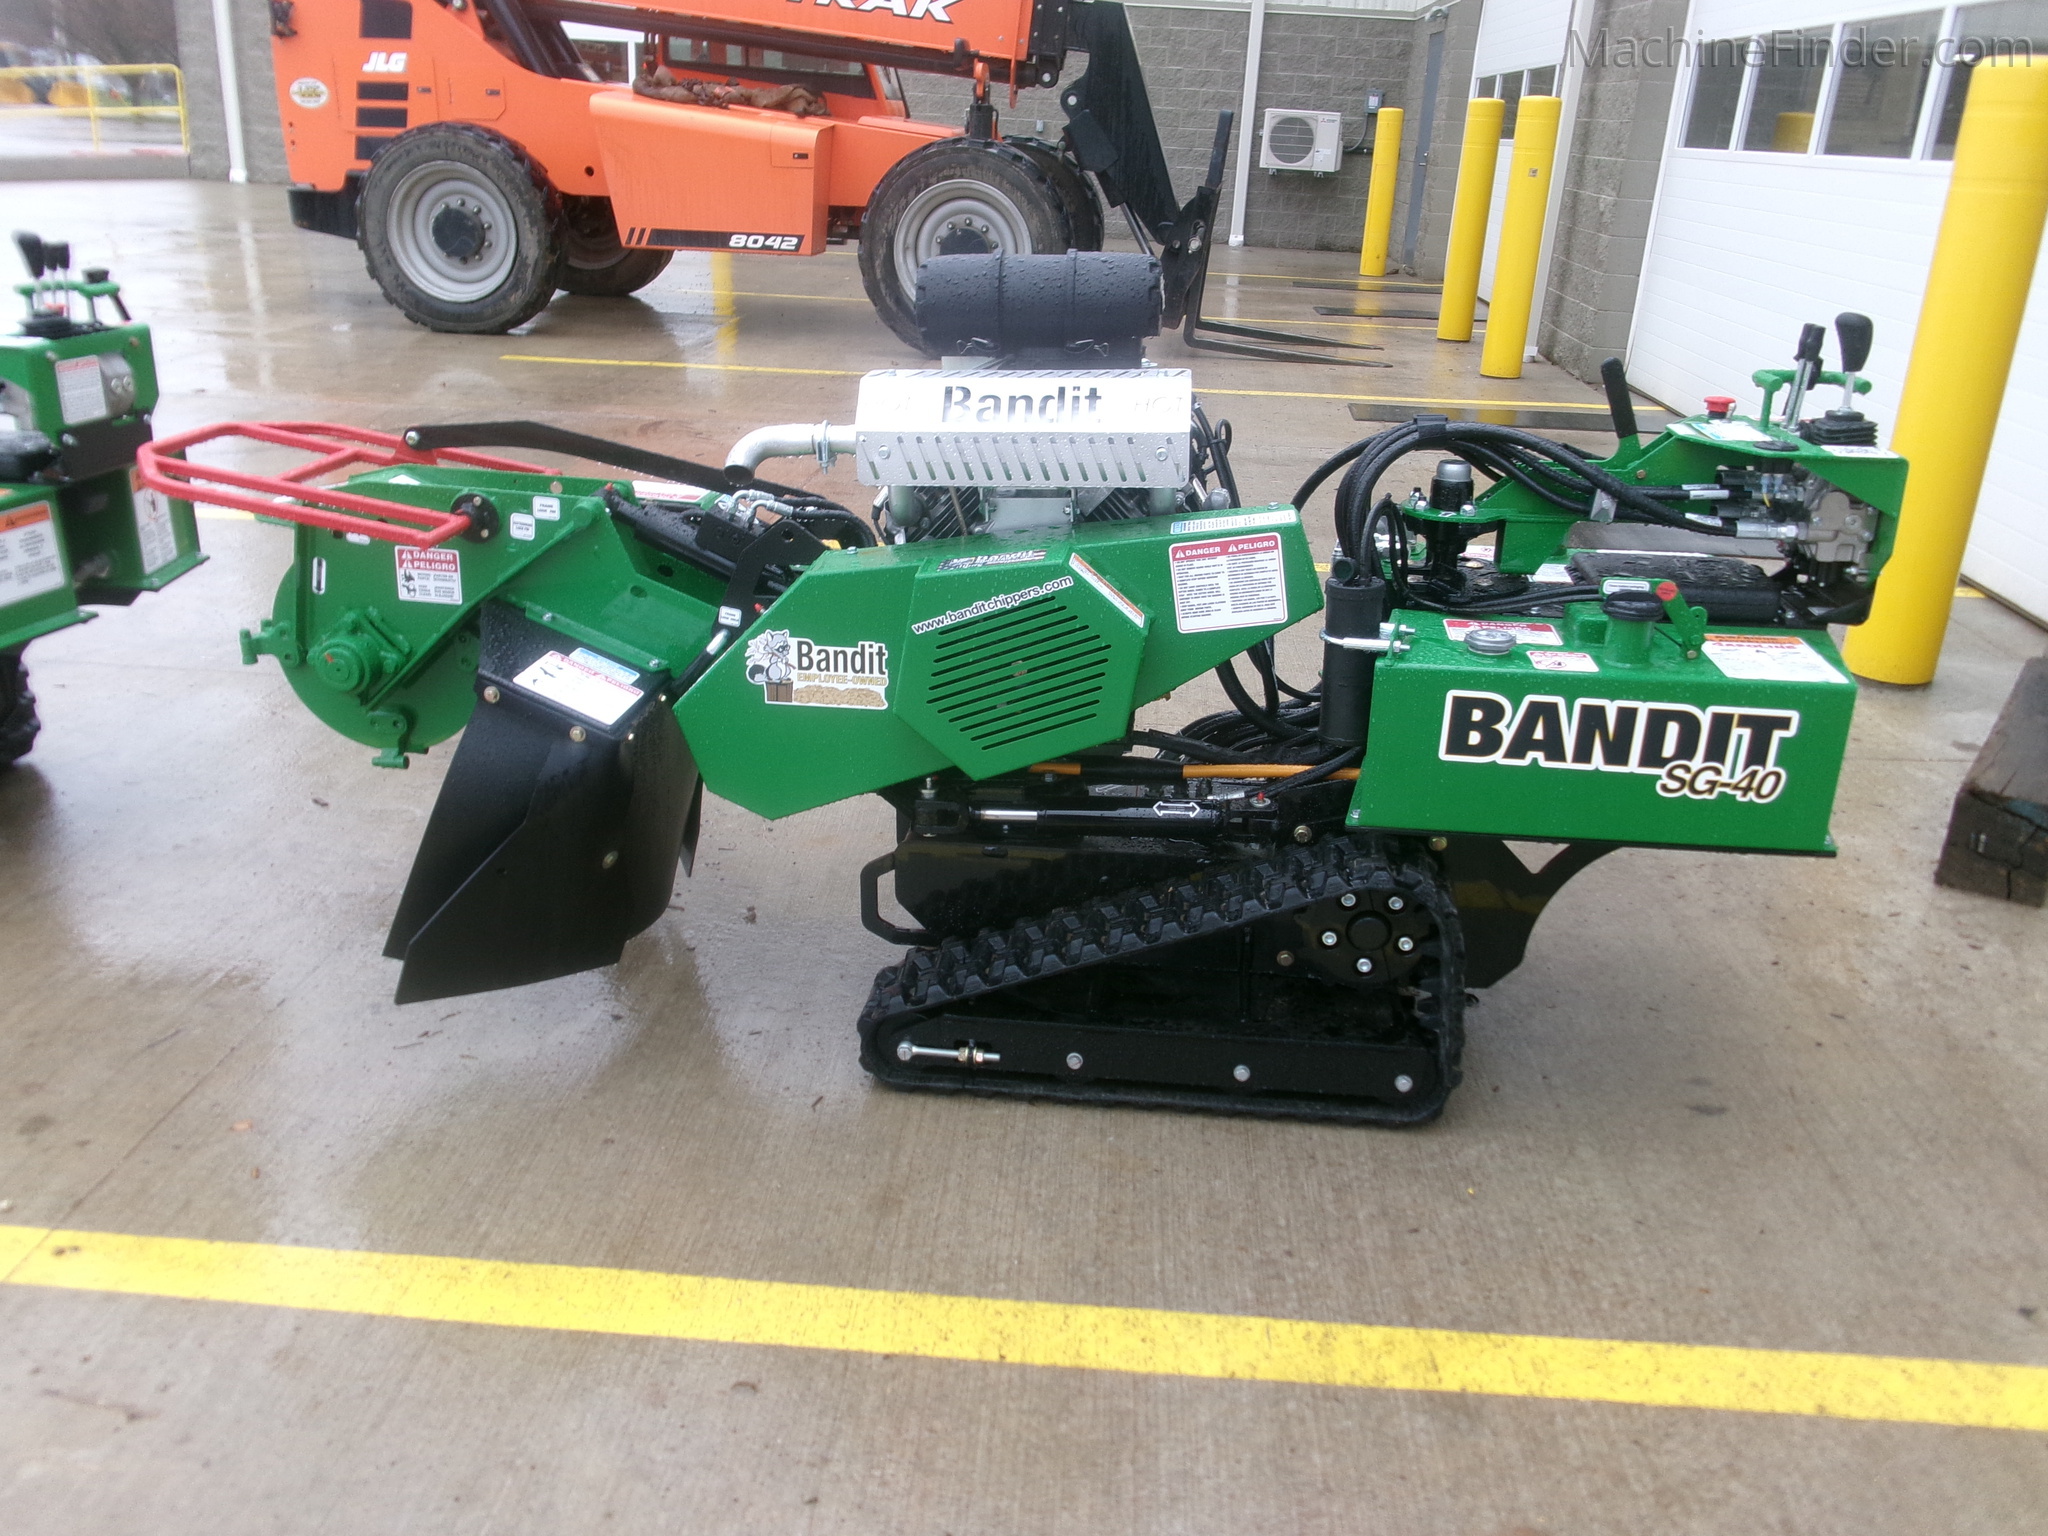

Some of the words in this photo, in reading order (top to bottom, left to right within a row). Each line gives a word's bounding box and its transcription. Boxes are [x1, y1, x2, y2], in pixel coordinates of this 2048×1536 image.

[361, 51, 407, 72] JLG
[728, 234, 799, 251] 8042
[941, 386, 1102, 423] Bandit
[413, 550, 453, 562] DANGER
[1186, 546, 1221, 557] DANGER
[1238, 540, 1276, 551] PELIGRO
[413, 560, 456, 571] PELIGRO
[913, 576, 1073, 633] www.banditchippers.com
[797, 640, 886, 676] Bandit
[797, 673, 888, 687] EMPLOYEE-OWNED
[1445, 695, 1793, 770] BANDIT
[1659, 763, 1782, 799] SG-40
